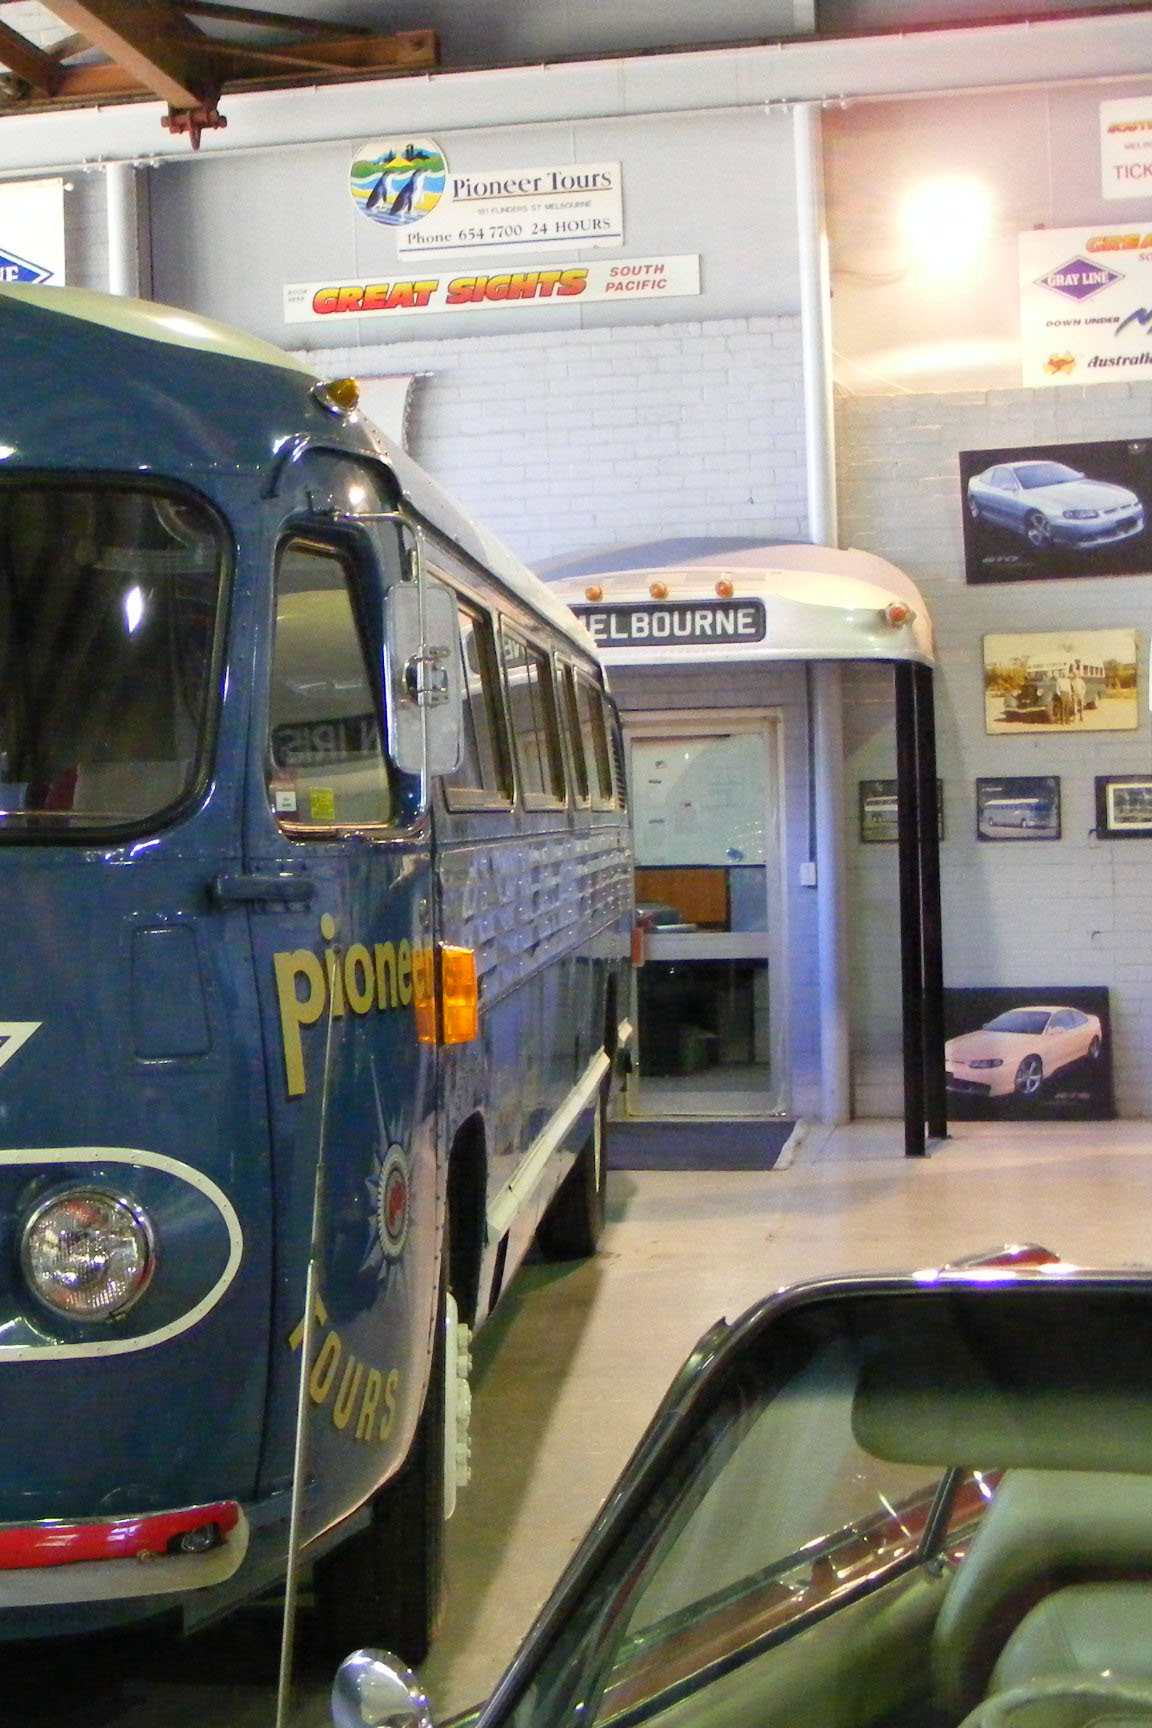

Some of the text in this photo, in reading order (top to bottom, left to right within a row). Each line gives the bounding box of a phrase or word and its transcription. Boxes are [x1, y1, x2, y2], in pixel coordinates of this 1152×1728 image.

[453, 171, 612, 198] Pioneer Tours
[408, 218, 611, 244] Phone 654 7700 24 HOURS
[609, 264, 665, 277] SOUTH
[1047, 271, 1110, 287] GRAY LINE
[312, 268, 588, 314] GREAT SIGHTS
[605, 278, 667, 293] PACIFIC
[1046, 317, 1120, 327] DOWN UNDER
[288, 1291, 399, 1441] TOURS
